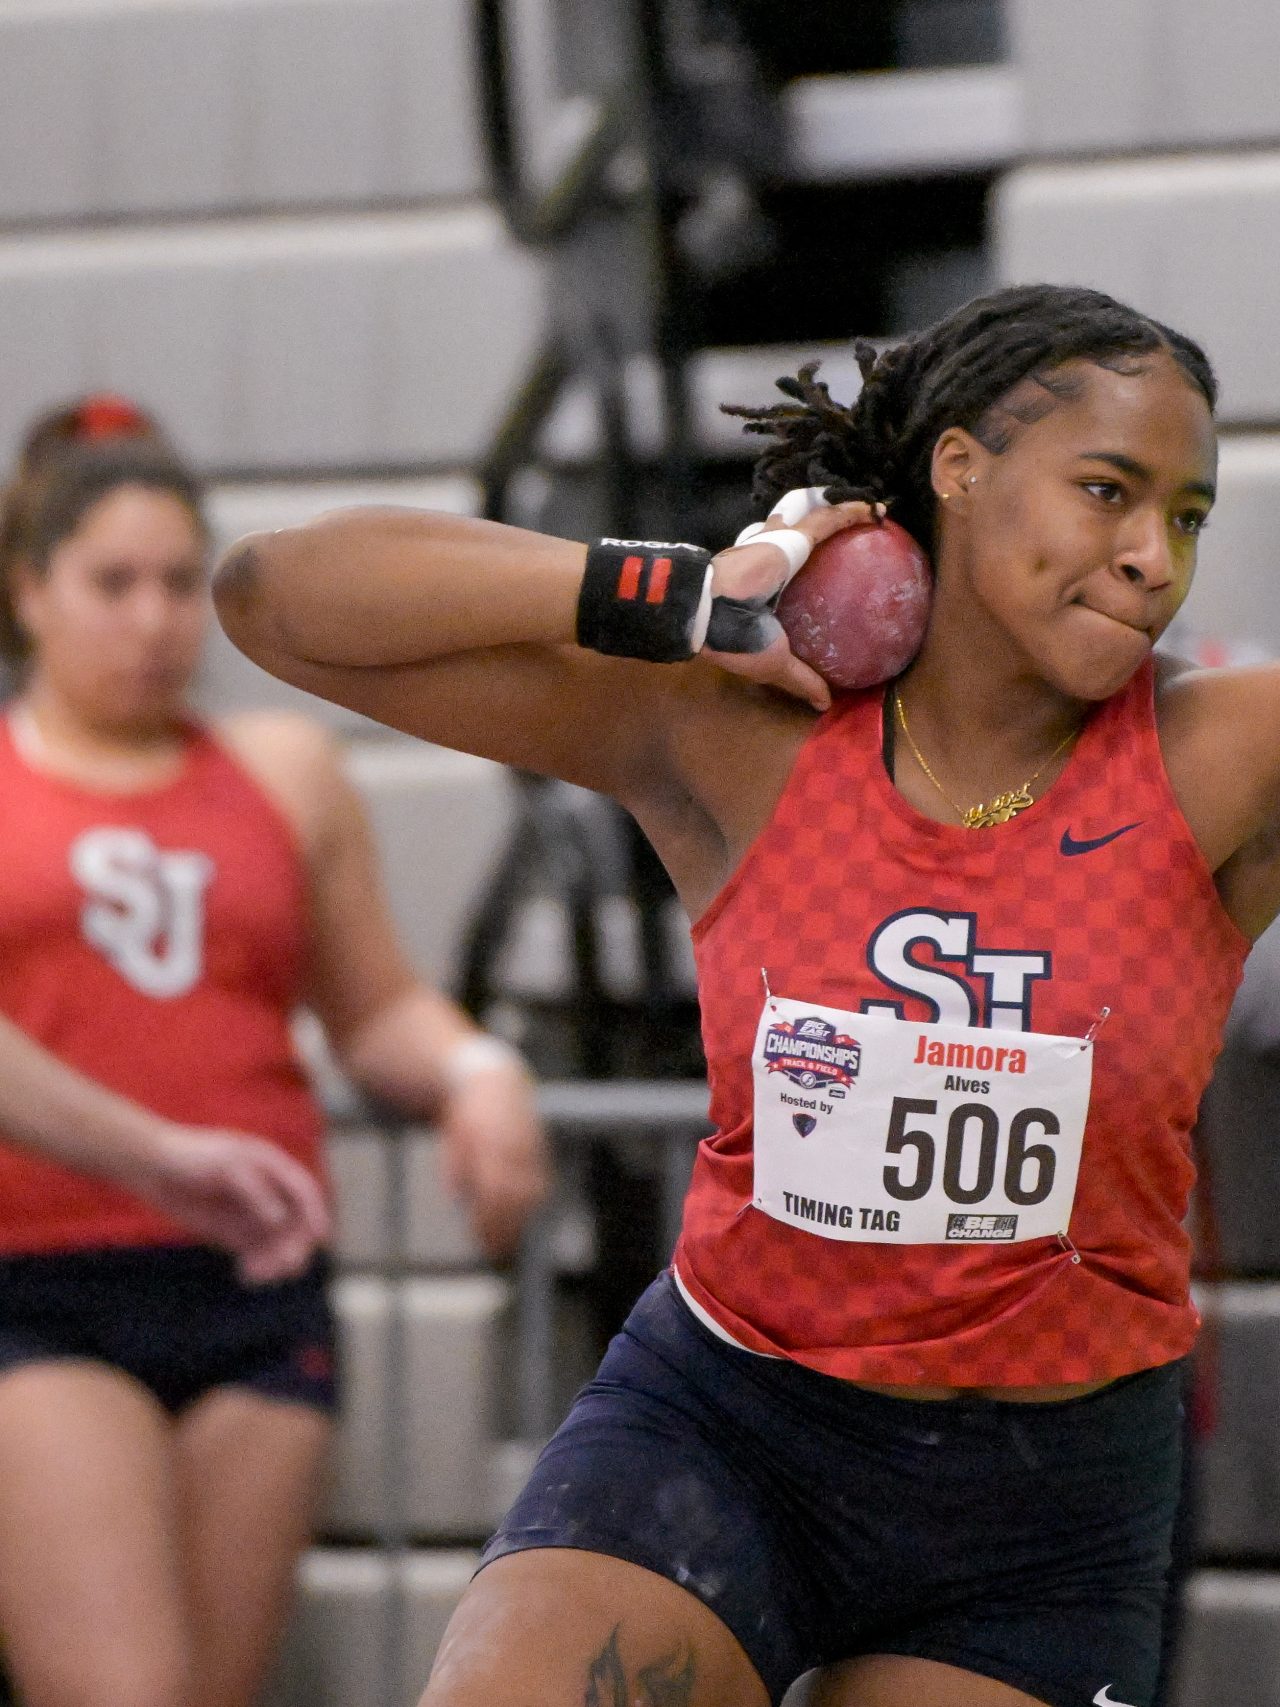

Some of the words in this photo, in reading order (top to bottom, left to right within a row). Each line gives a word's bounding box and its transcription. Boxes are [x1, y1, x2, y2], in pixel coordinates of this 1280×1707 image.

[799, 1026, 831, 1037] EAST
[804, 1020, 827, 1030] BIG
[766, 1033, 859, 1070] CHAMPIONSHIPS
[913, 1035, 1027, 1074] Jamora
[782, 1058, 806, 1068] TRACK
[815, 1064, 838, 1076] FIELD
[944, 1075, 991, 1094] Alves
[780, 1092, 817, 1110] Hosted
[819, 1101, 834, 1115] by
[882, 1096, 1061, 1206] 506
[783, 1191, 853, 1229] TIMING
[859, 1207, 900, 1232] TAG
[947, 1228, 1014, 1238] CHANGE
